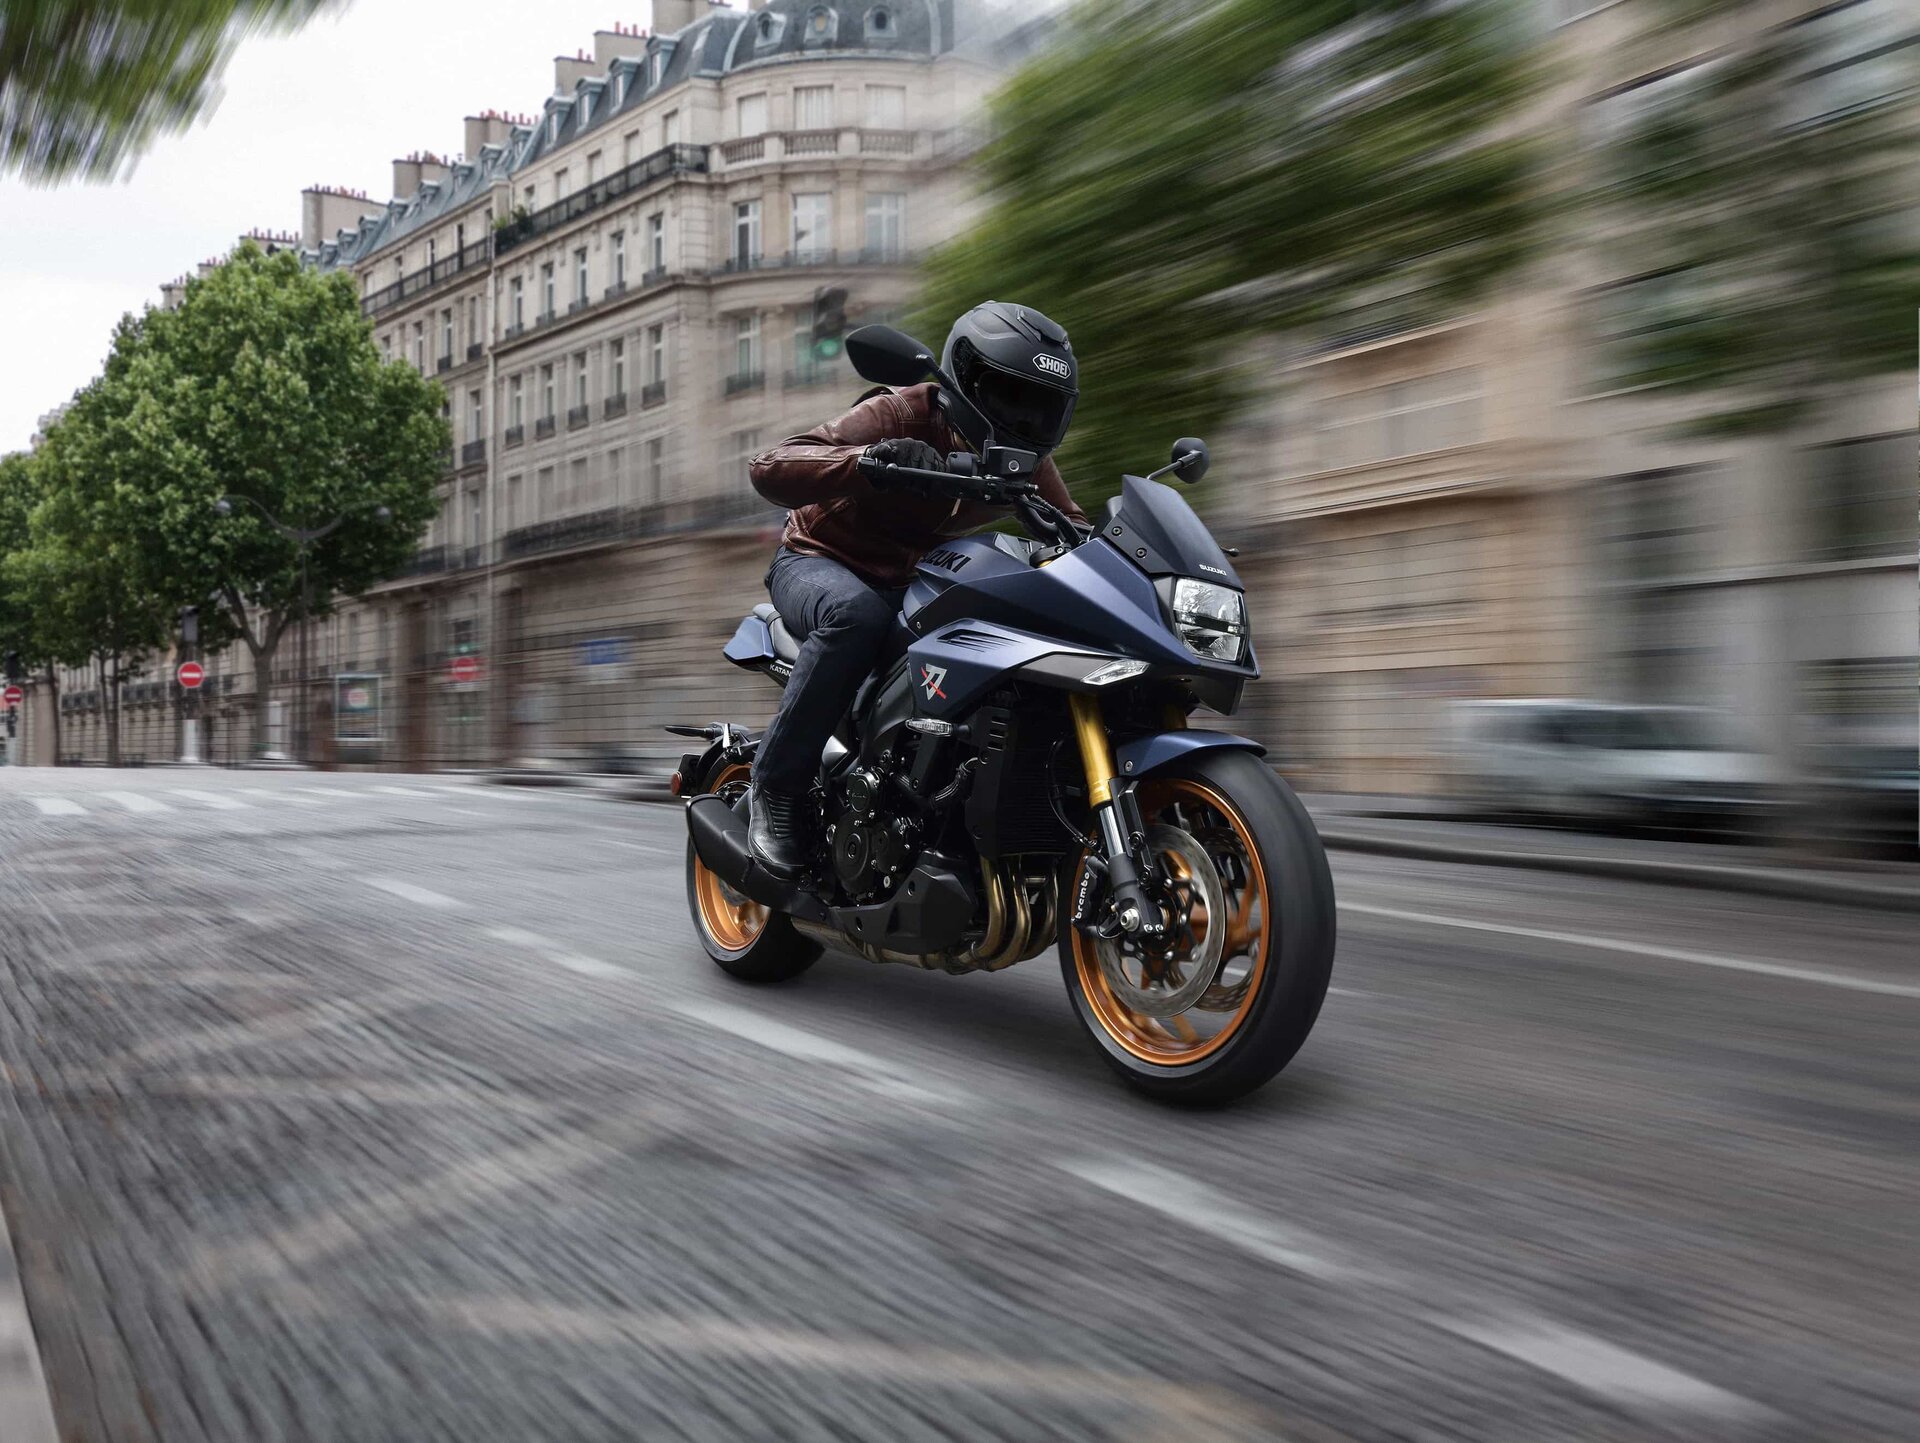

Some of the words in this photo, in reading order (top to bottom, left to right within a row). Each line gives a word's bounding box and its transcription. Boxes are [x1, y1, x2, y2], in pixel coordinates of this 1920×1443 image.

[1039, 356, 1068, 377] SHOEI
[920, 549, 972, 573] ZUKI
[1198, 563, 1227, 576] SUZUKI
[770, 663, 792, 677] KATAN
[1075, 871, 1090, 919] brembo
